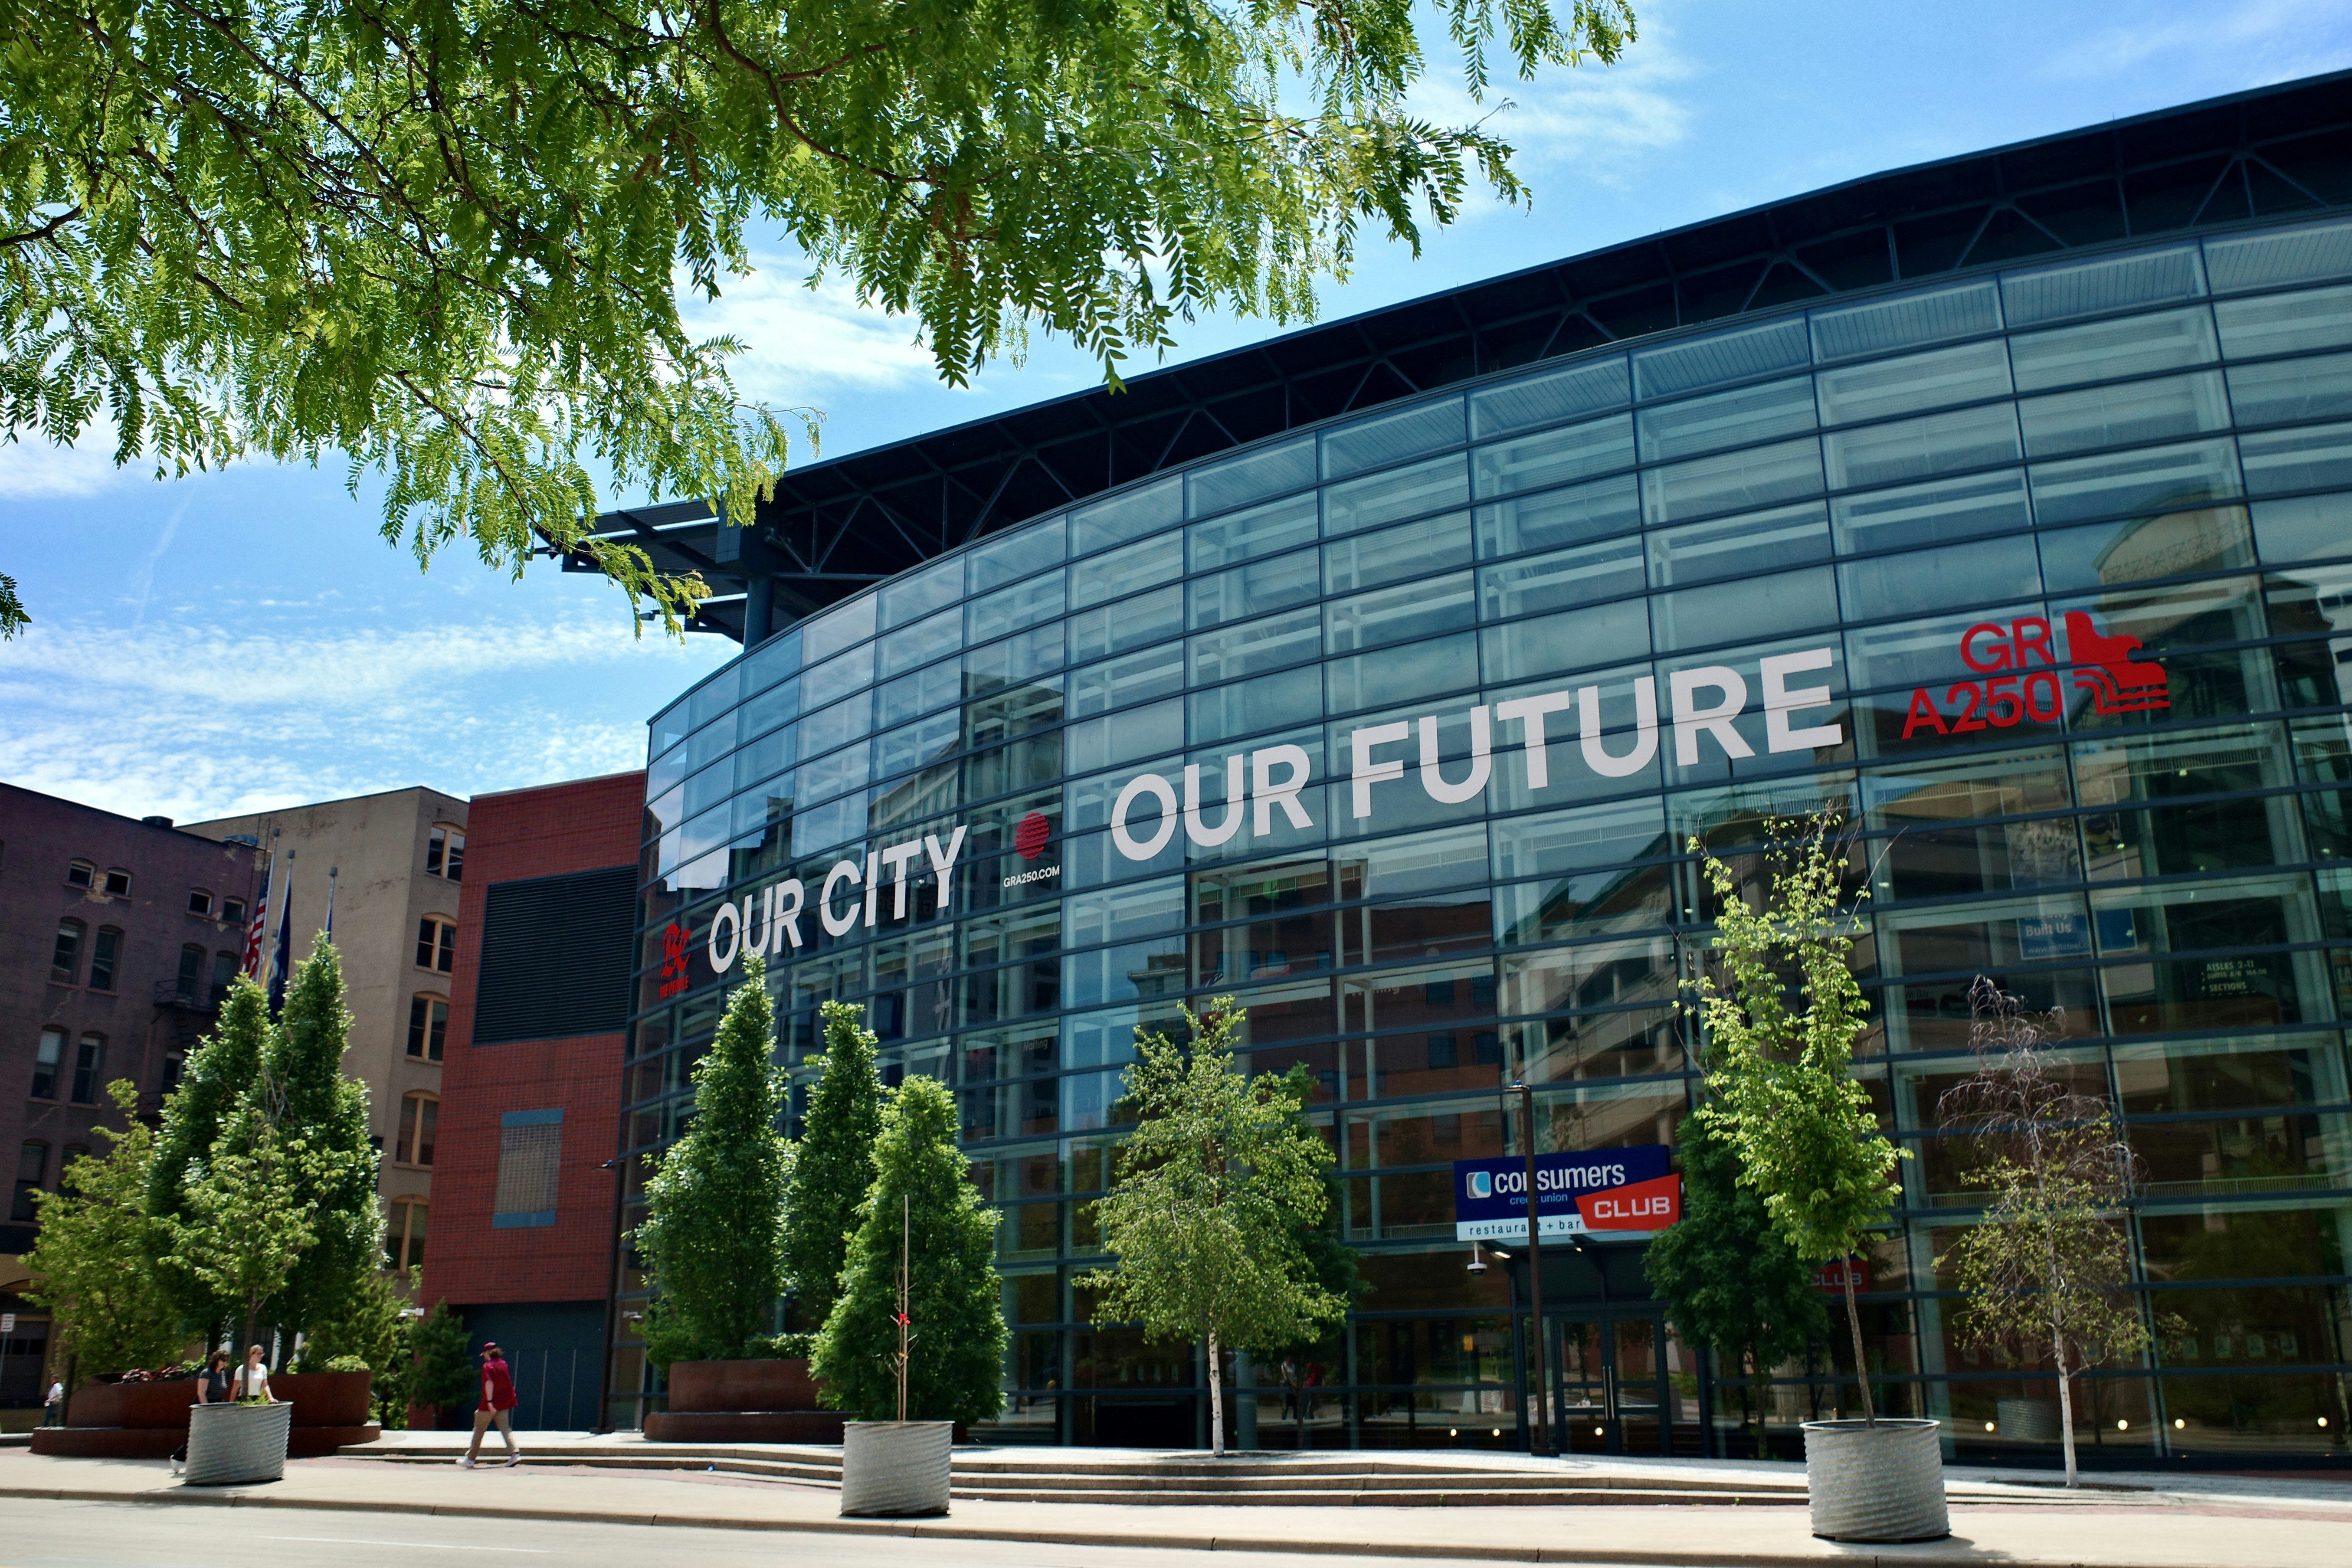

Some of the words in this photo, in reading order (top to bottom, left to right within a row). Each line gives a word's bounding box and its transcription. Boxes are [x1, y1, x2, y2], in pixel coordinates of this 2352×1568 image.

[1960, 617, 2056, 673] GR
[1902, 671, 2063, 739] A250
[1110, 744, 1314, 861] OUR
[1351, 647, 1843, 819] FUTURE
[1003, 864, 1060, 888] GRA250.COM
[708, 878, 804, 974] OUR
[819, 824, 968, 937] CITY
[2025, 923, 2053, 937] Built
[2056, 922, 2072, 933] Us
[2207, 962, 2234, 972] AISLES
[669, 975, 689, 994] PEOPLE
[2209, 982, 2247, 992] SECTIONS
[1540, 1192, 1568, 1203] union
[1594, 1196, 1671, 1219] CLUB
[1469, 1221, 1541, 1236] restaurat
[1559, 1219, 1581, 1230] bar
